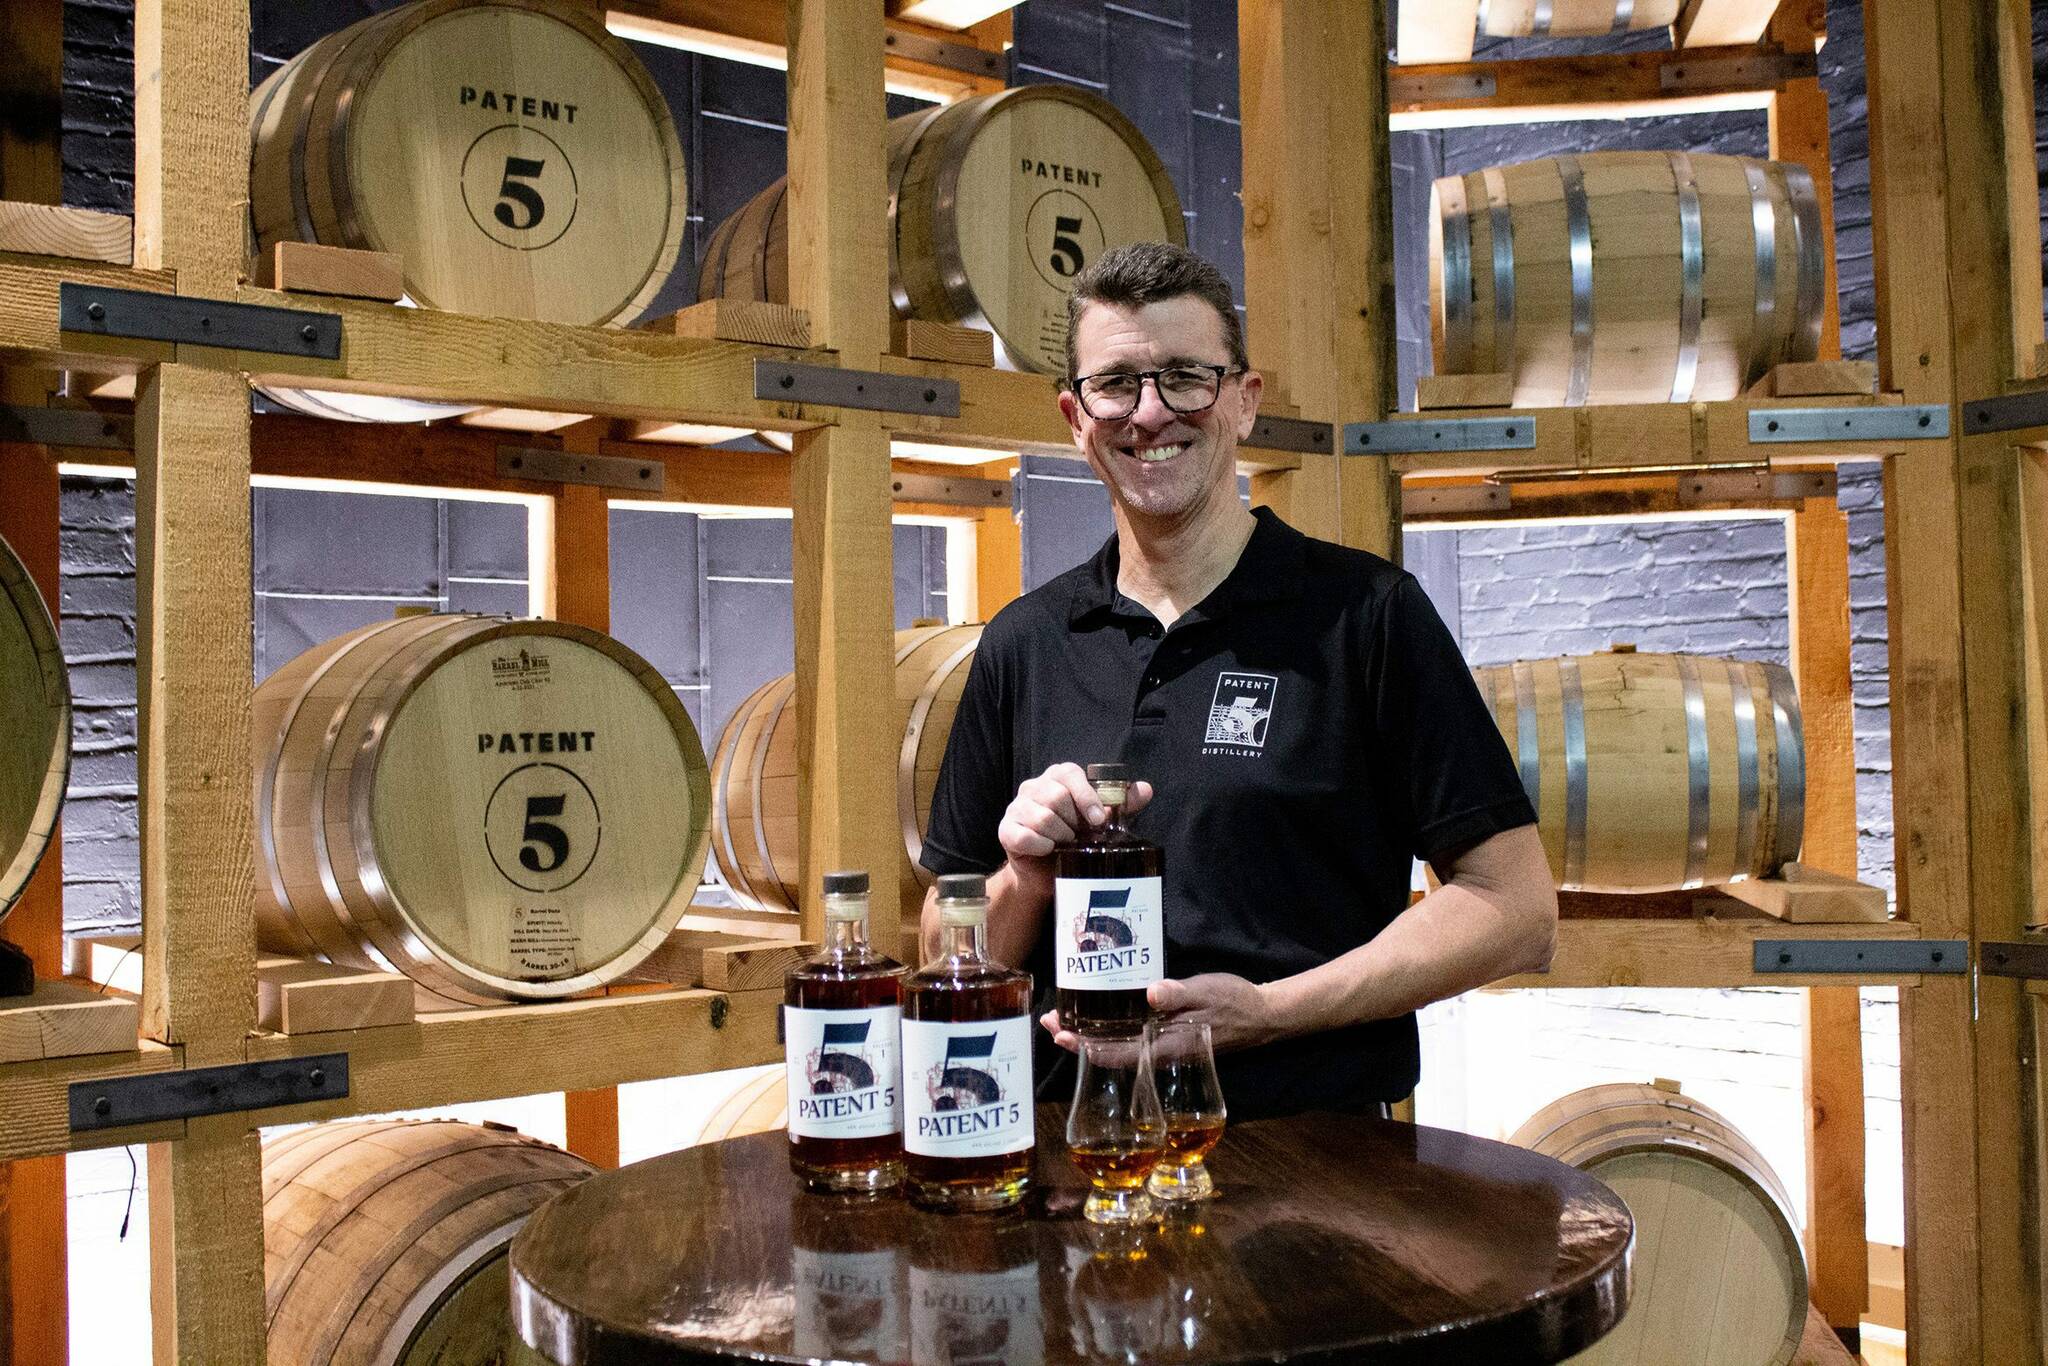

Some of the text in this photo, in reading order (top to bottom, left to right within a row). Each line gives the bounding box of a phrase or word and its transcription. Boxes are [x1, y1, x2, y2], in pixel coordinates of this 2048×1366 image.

[460, 86, 578, 123] PATENT
[1022, 159, 1102, 187] PATENT
[494, 157, 545, 229] 5
[1050, 216, 1084, 277] 5
[1224, 679, 1270, 690] PATENT
[478, 731, 596, 754] PATENT
[1202, 747, 1263, 758] DISTILLERY
[519, 794, 570, 873] 5
[521, 958, 548, 971] BARREL
[1067, 947, 1150, 974] PATENT 5
[800, 1087, 895, 1119] PATENT 5
[918, 1102, 1020, 1137] PATENT 5
